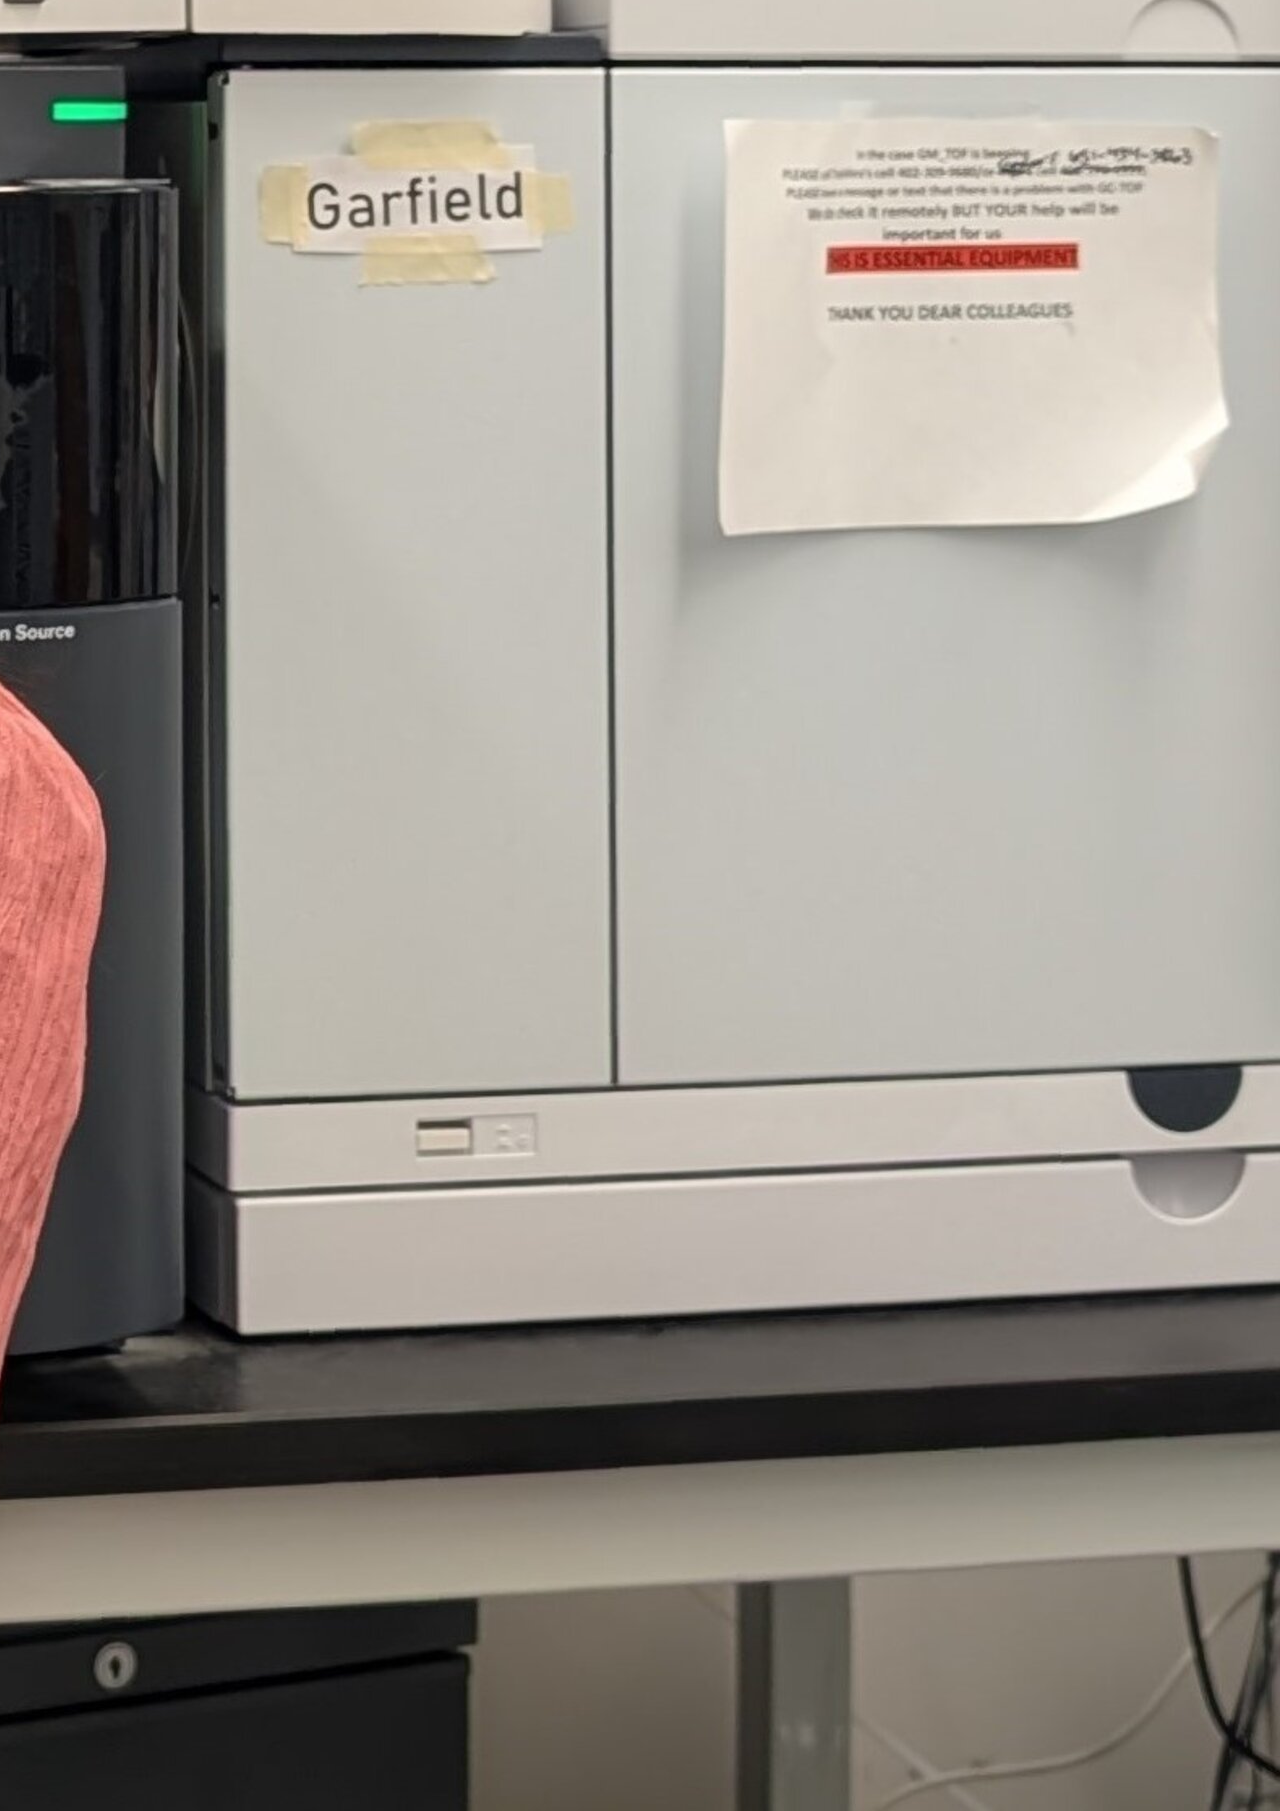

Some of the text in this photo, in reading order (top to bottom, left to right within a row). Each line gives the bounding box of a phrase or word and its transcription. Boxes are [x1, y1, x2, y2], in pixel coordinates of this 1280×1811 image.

[306, 171, 523, 230] Garfield
[881, 205, 947, 219] remotely
[952, 204, 980, 217] BUT
[986, 203, 1028, 217] YOUR
[1031, 203, 1065, 217] help
[1069, 203, 1095, 214] will
[1100, 203, 1119, 214] be
[882, 226, 1001, 242] important for us
[873, 250, 964, 268] ESSENTIAL
[970, 248, 1077, 266] EQUIPMENT
[878, 305, 914, 321] YOU
[918, 304, 962, 320] DEAR
[966, 302, 1075, 320] COLLEAGUES
[14, 623, 76, 641] Source
